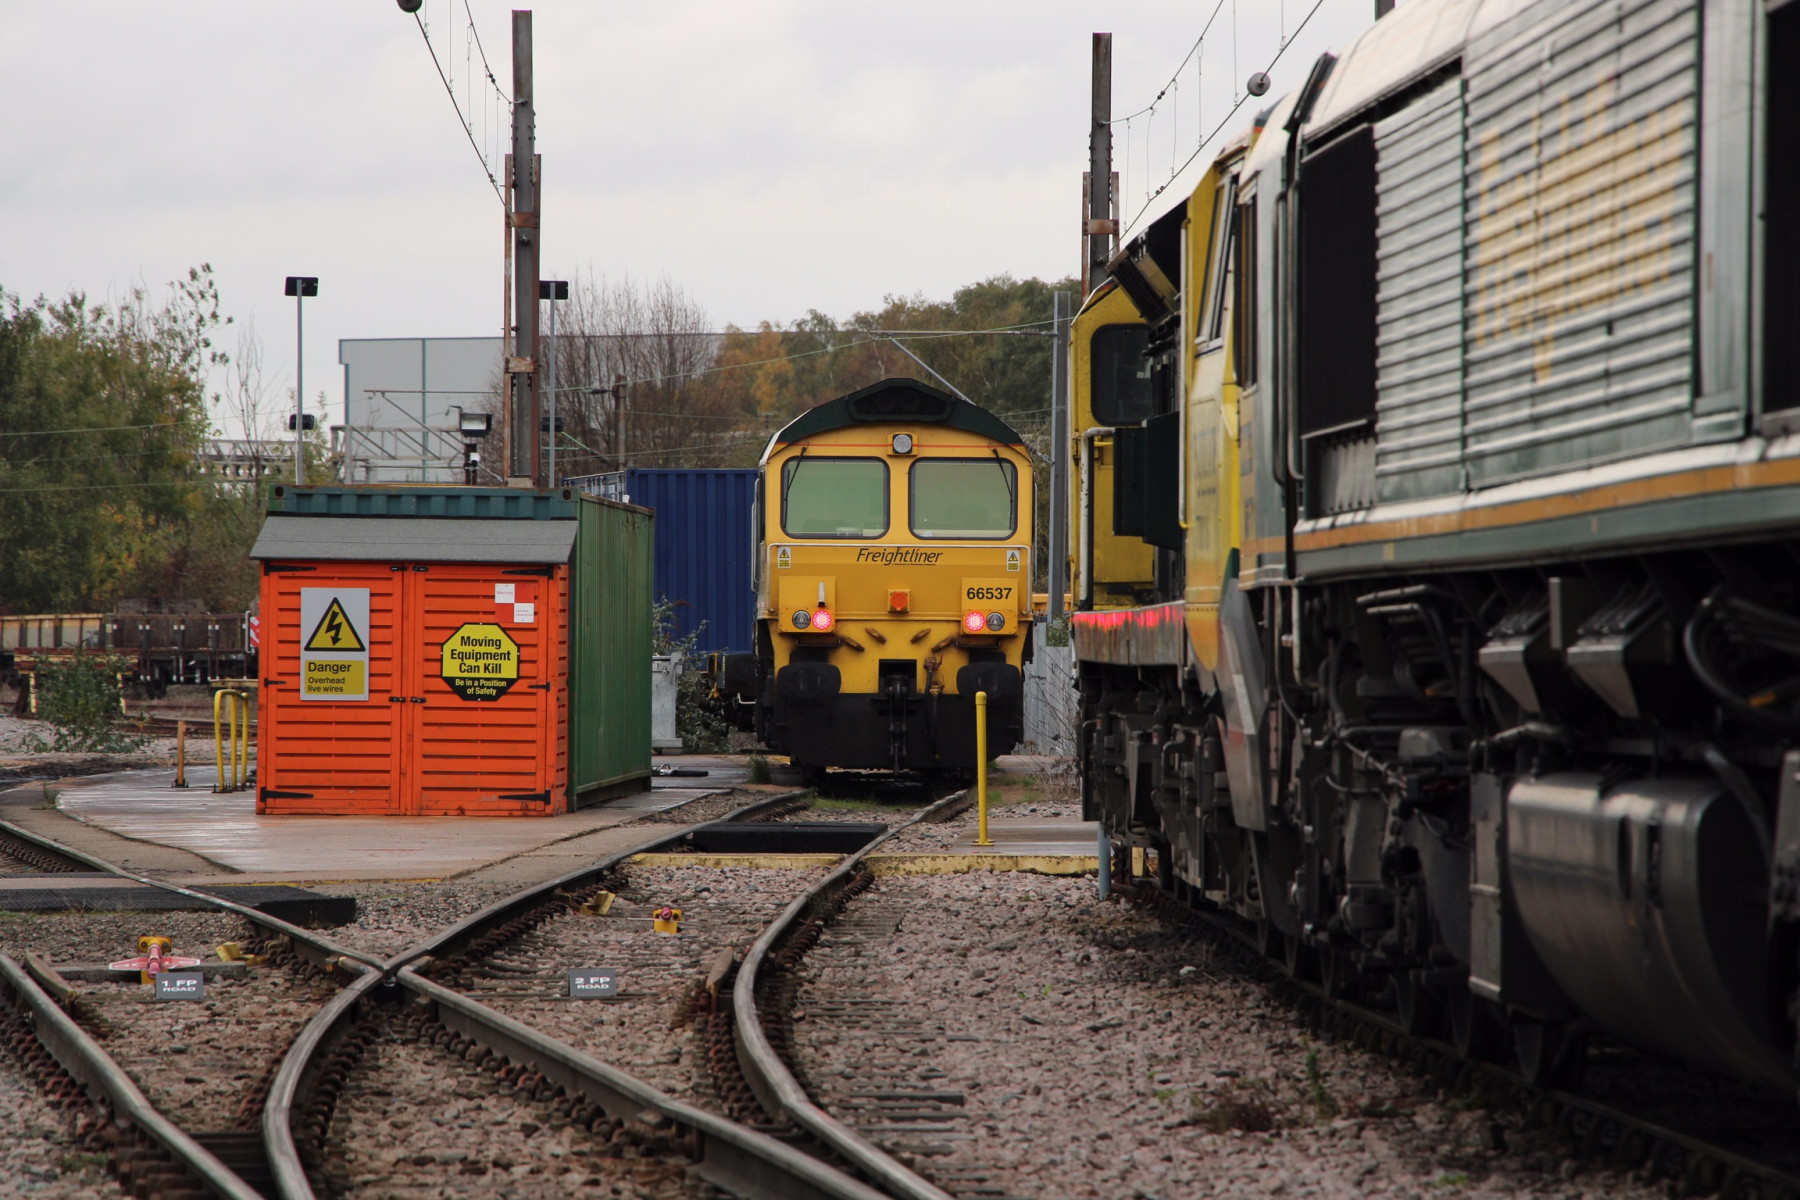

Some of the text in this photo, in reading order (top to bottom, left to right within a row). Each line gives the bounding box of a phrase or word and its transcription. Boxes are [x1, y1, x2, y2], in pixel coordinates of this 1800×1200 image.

[856, 548, 944, 566] Freightliner
[966, 588, 1012, 600] 66537
[460, 636, 502, 649] Moving
[450, 650, 511, 662] Equipment
[308, 662, 352, 674] Danger
[459, 663, 502, 674] Can Kill
[476, 687, 496, 696] Safety
